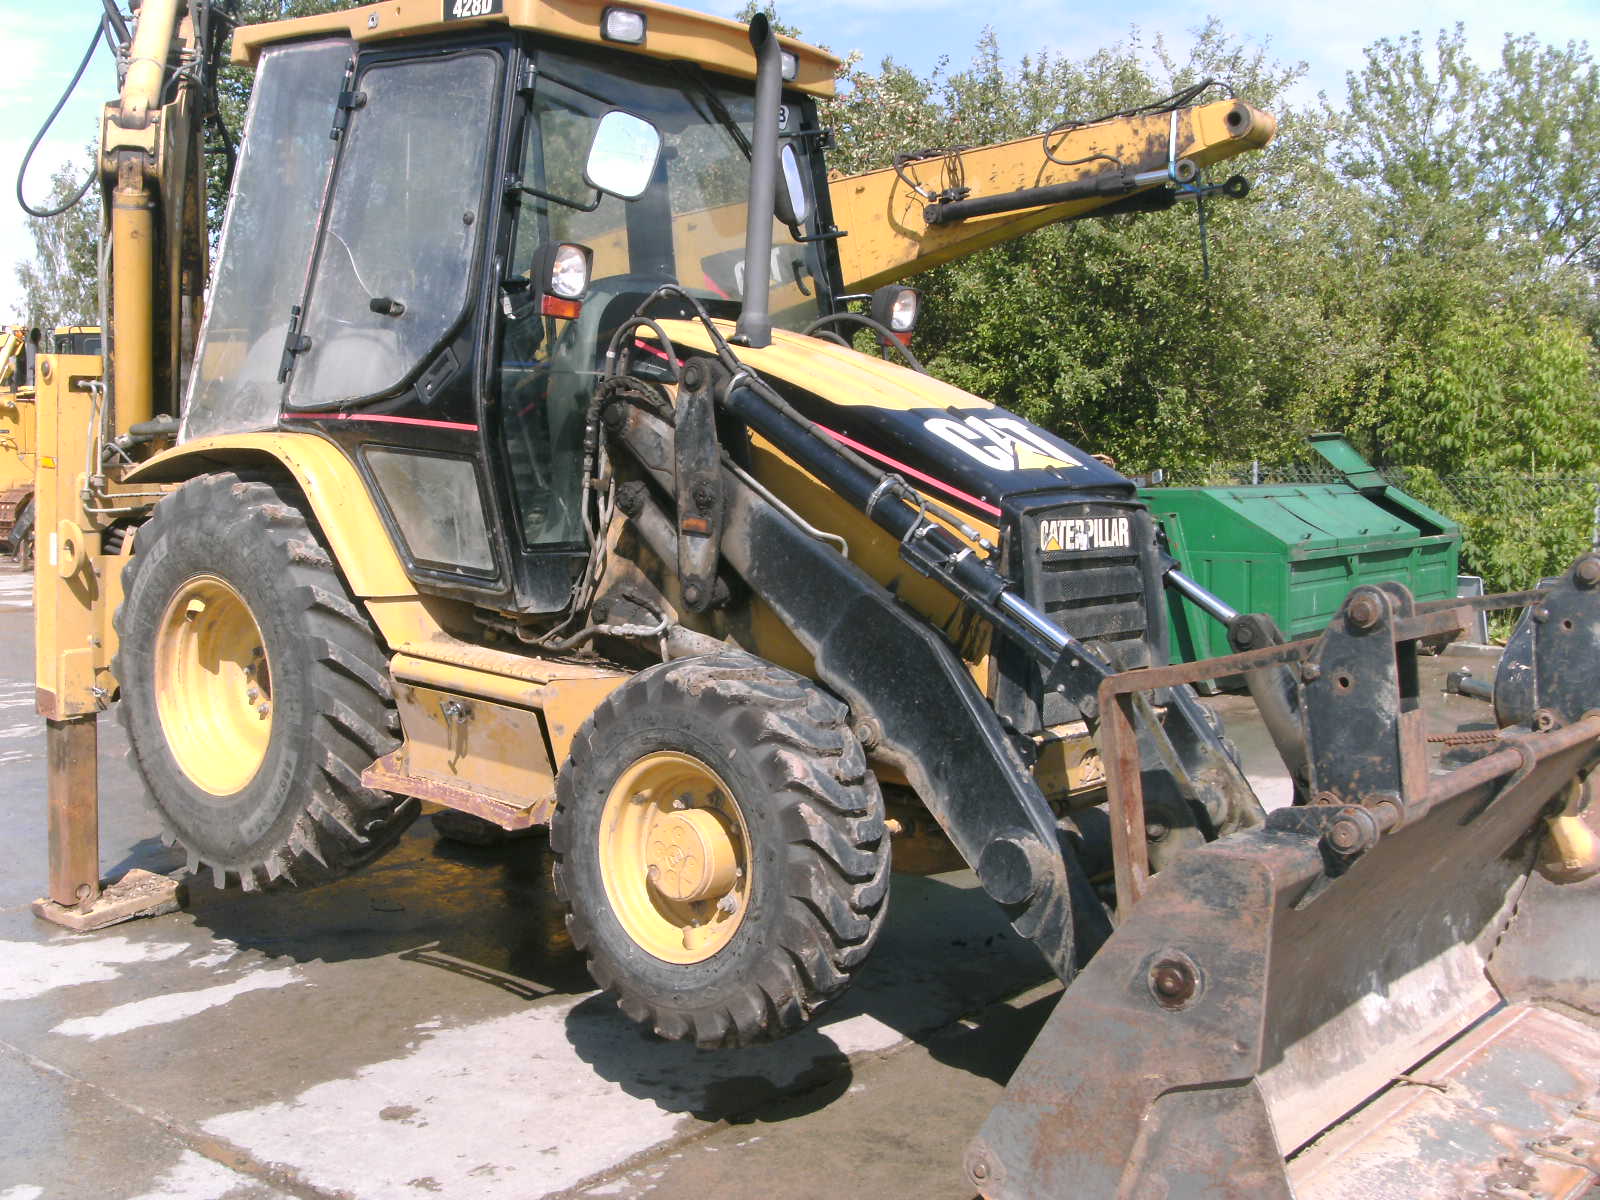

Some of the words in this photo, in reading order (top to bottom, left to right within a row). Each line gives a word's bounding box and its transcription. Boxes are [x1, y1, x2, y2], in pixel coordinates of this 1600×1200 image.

[453, 0, 492, 17] 428D
[923, 415, 1084, 471] CAT
[1040, 517, 1130, 551] CATERPILLAR
